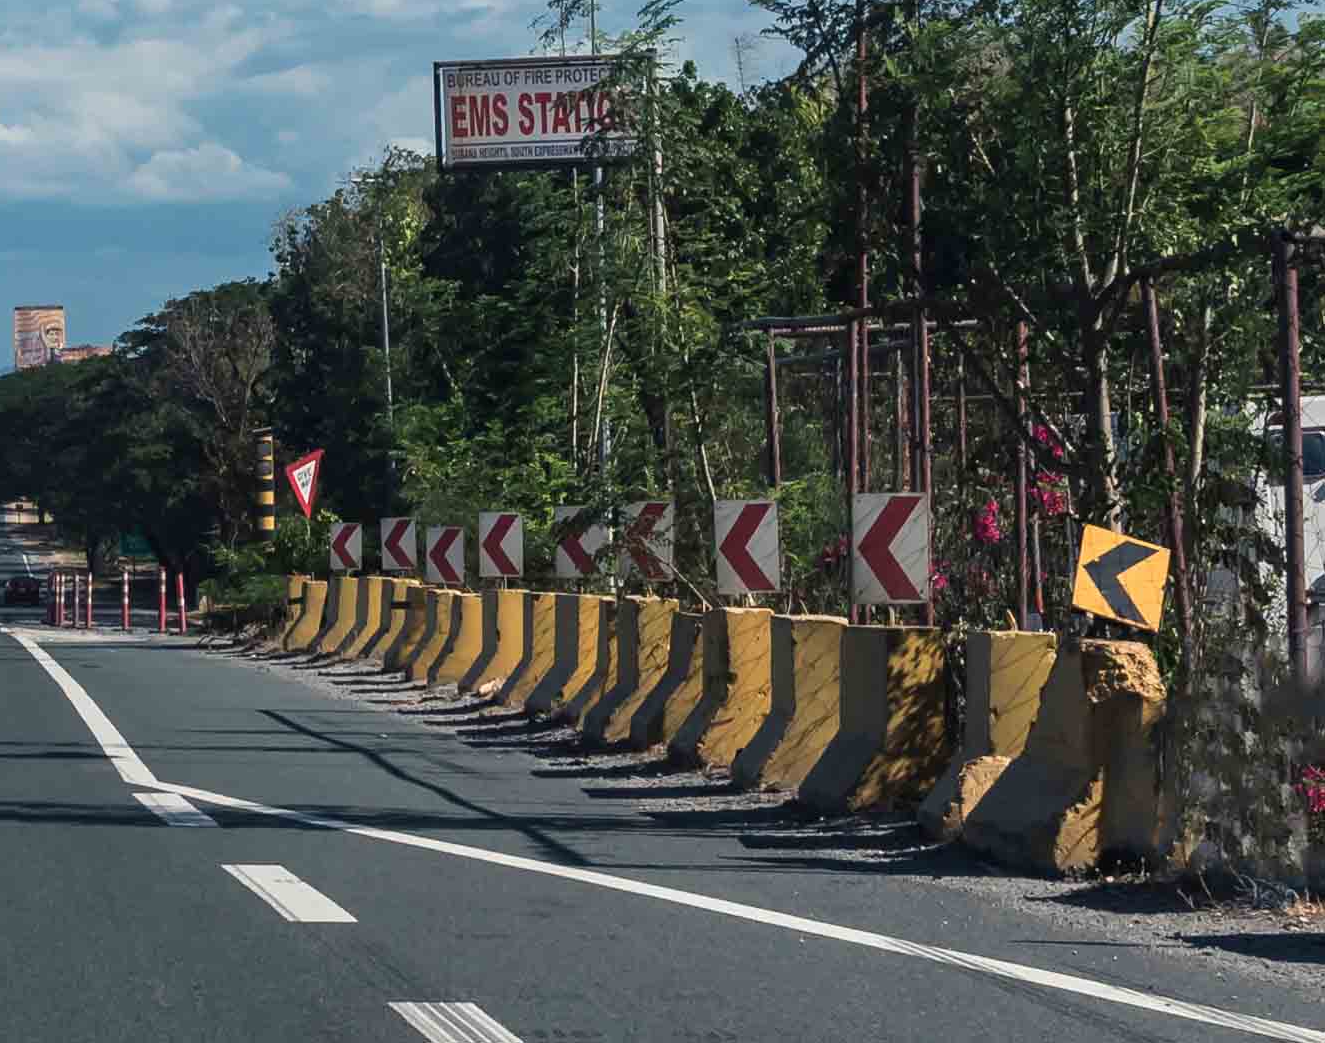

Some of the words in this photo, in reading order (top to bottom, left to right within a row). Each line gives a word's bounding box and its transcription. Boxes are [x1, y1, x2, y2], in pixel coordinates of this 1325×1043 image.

[447, 71, 500, 88] BUREAU
[503, 70, 520, 86] OF
[524, 69, 552, 85] FIRE
[451, 92, 509, 138] EMS
